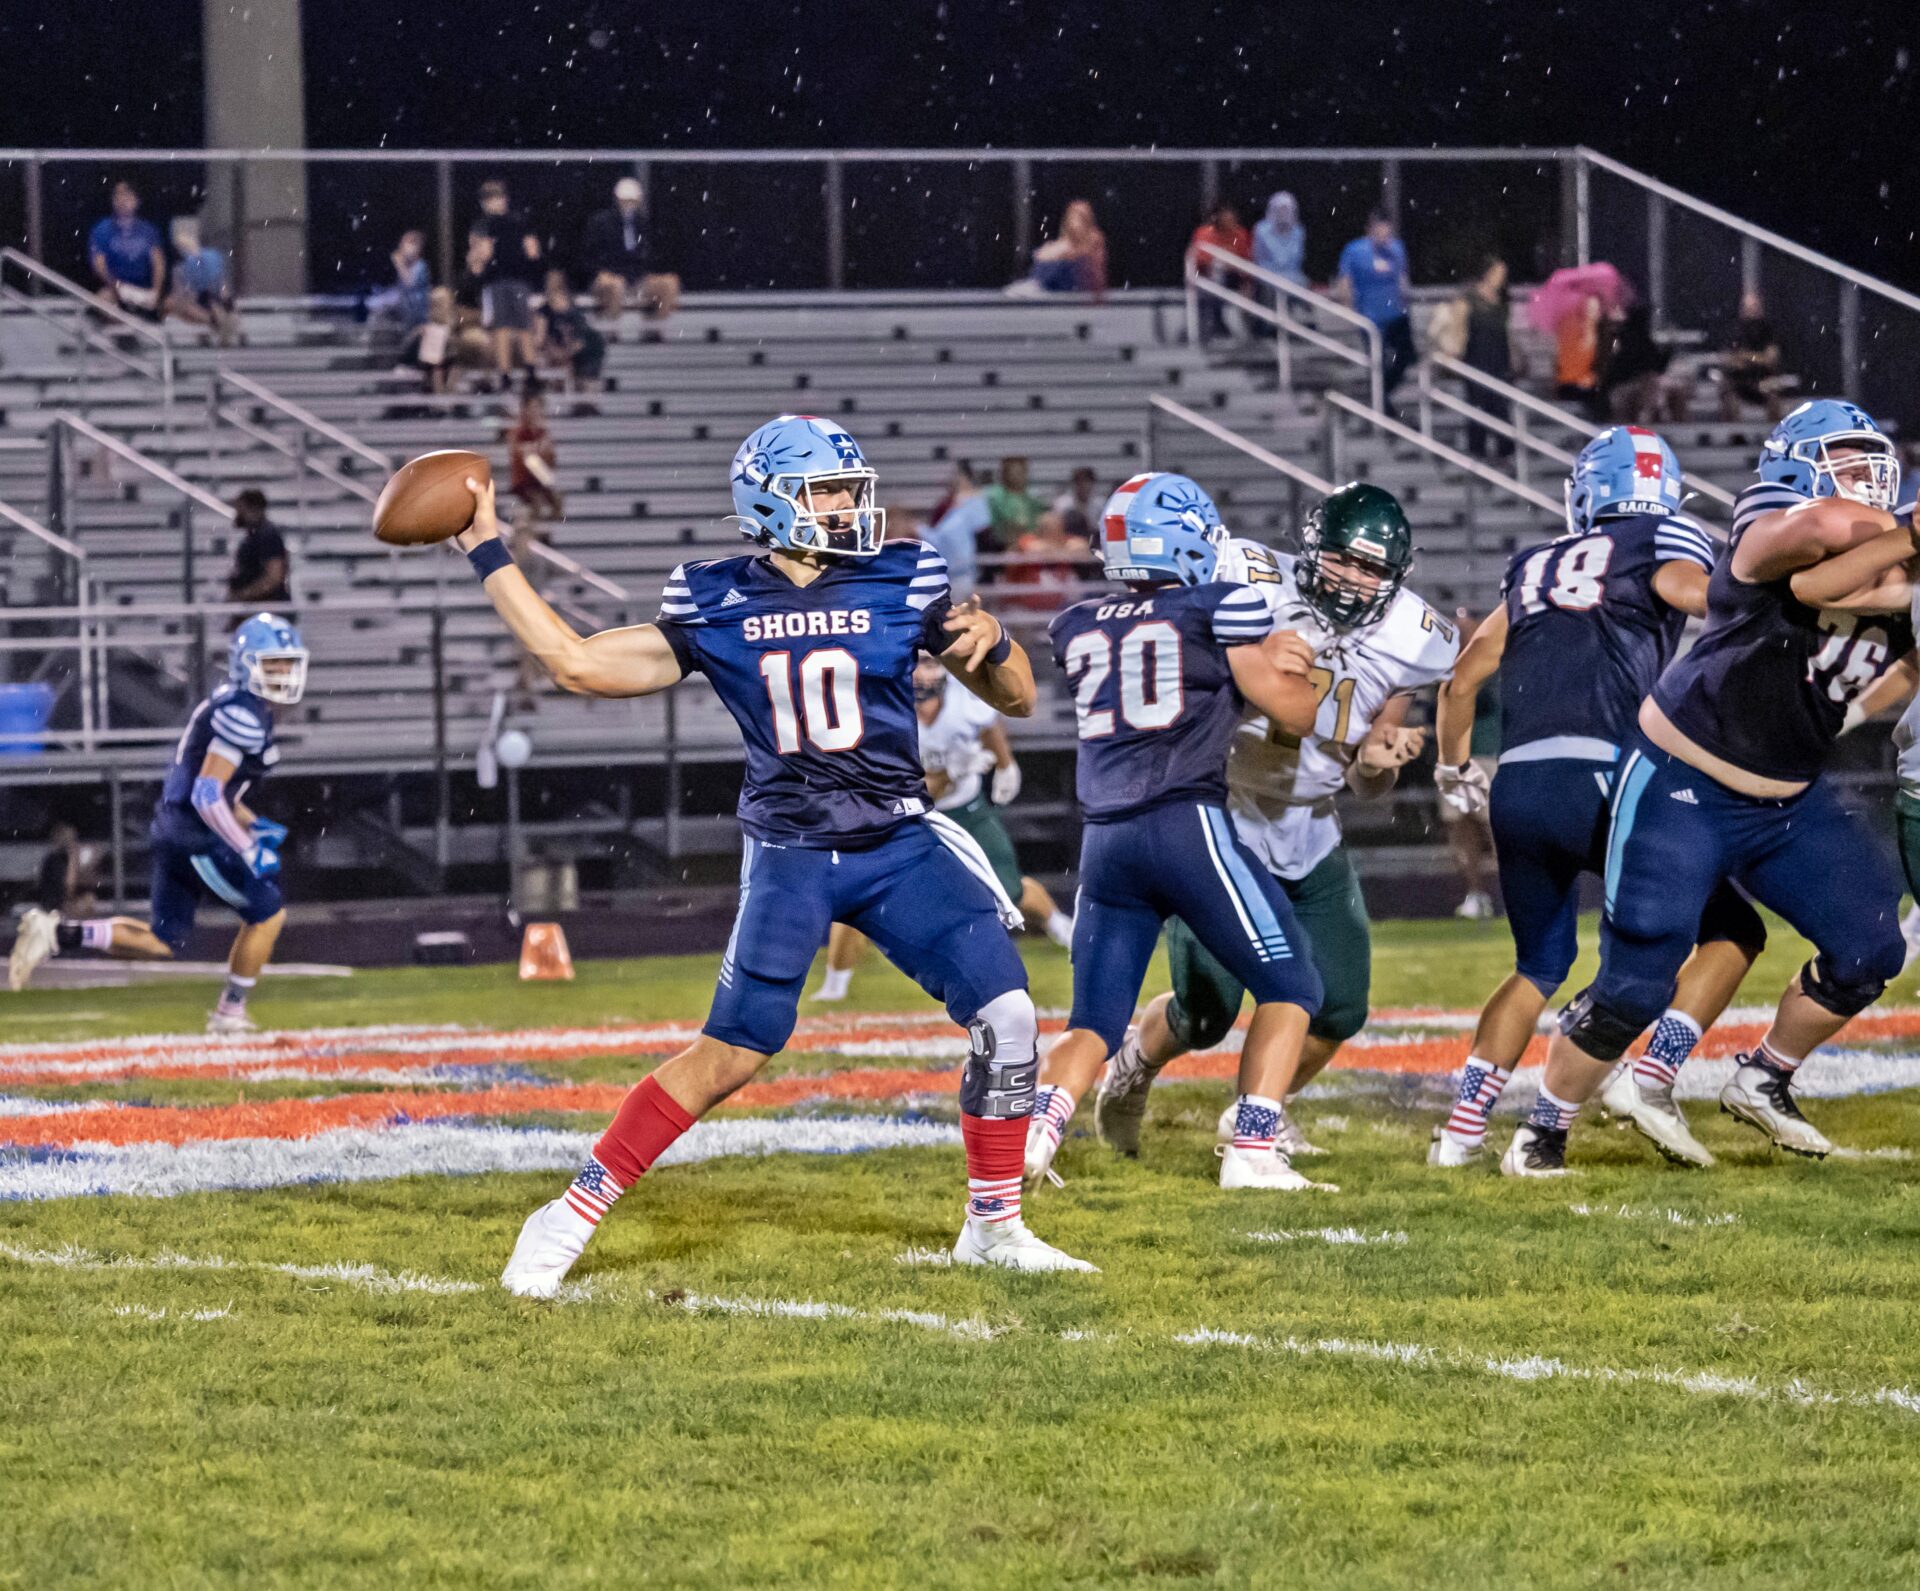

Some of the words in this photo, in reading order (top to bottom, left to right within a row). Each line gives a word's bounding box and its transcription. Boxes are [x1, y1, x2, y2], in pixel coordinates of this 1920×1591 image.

[1241, 547, 1283, 585] 71
[1520, 533, 1615, 615] 18
[742, 608, 872, 643] SHORES
[1095, 599, 1155, 621] USA
[759, 647, 865, 755] 10
[1065, 619, 1185, 741] 20
